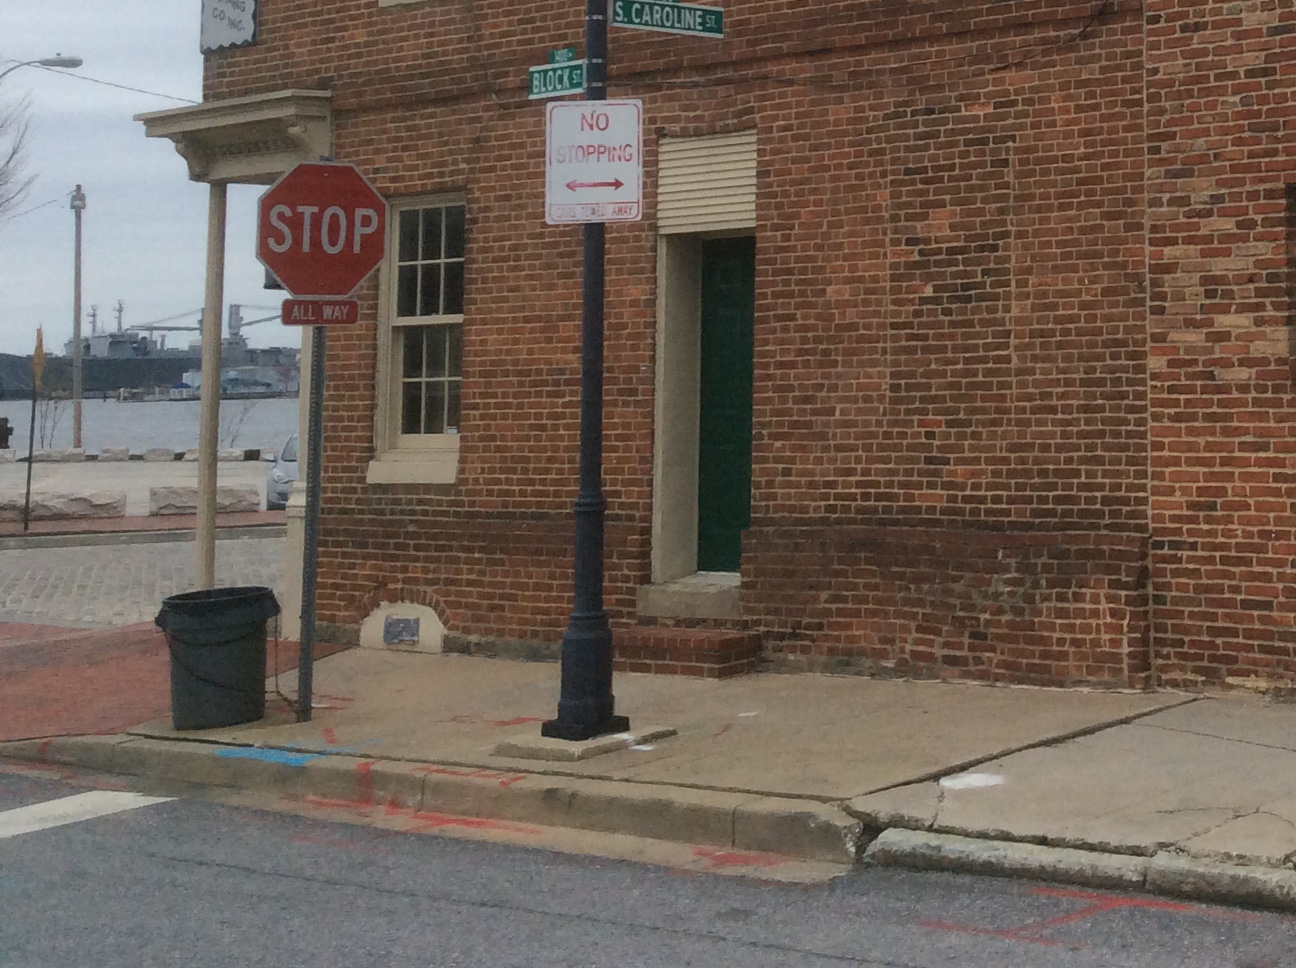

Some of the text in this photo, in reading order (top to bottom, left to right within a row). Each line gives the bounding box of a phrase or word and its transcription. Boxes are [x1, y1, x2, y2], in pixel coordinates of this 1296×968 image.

[615, 1, 718, 30] S. CAROLINE ST.
[532, 67, 570, 93] BLOCK
[580, 111, 610, 132] NO
[555, 143, 633, 164] STOPPING
[611, 204, 634, 216] AWAY
[267, 204, 378, 254] STOP
[291, 304, 349, 320] ALL WAY
